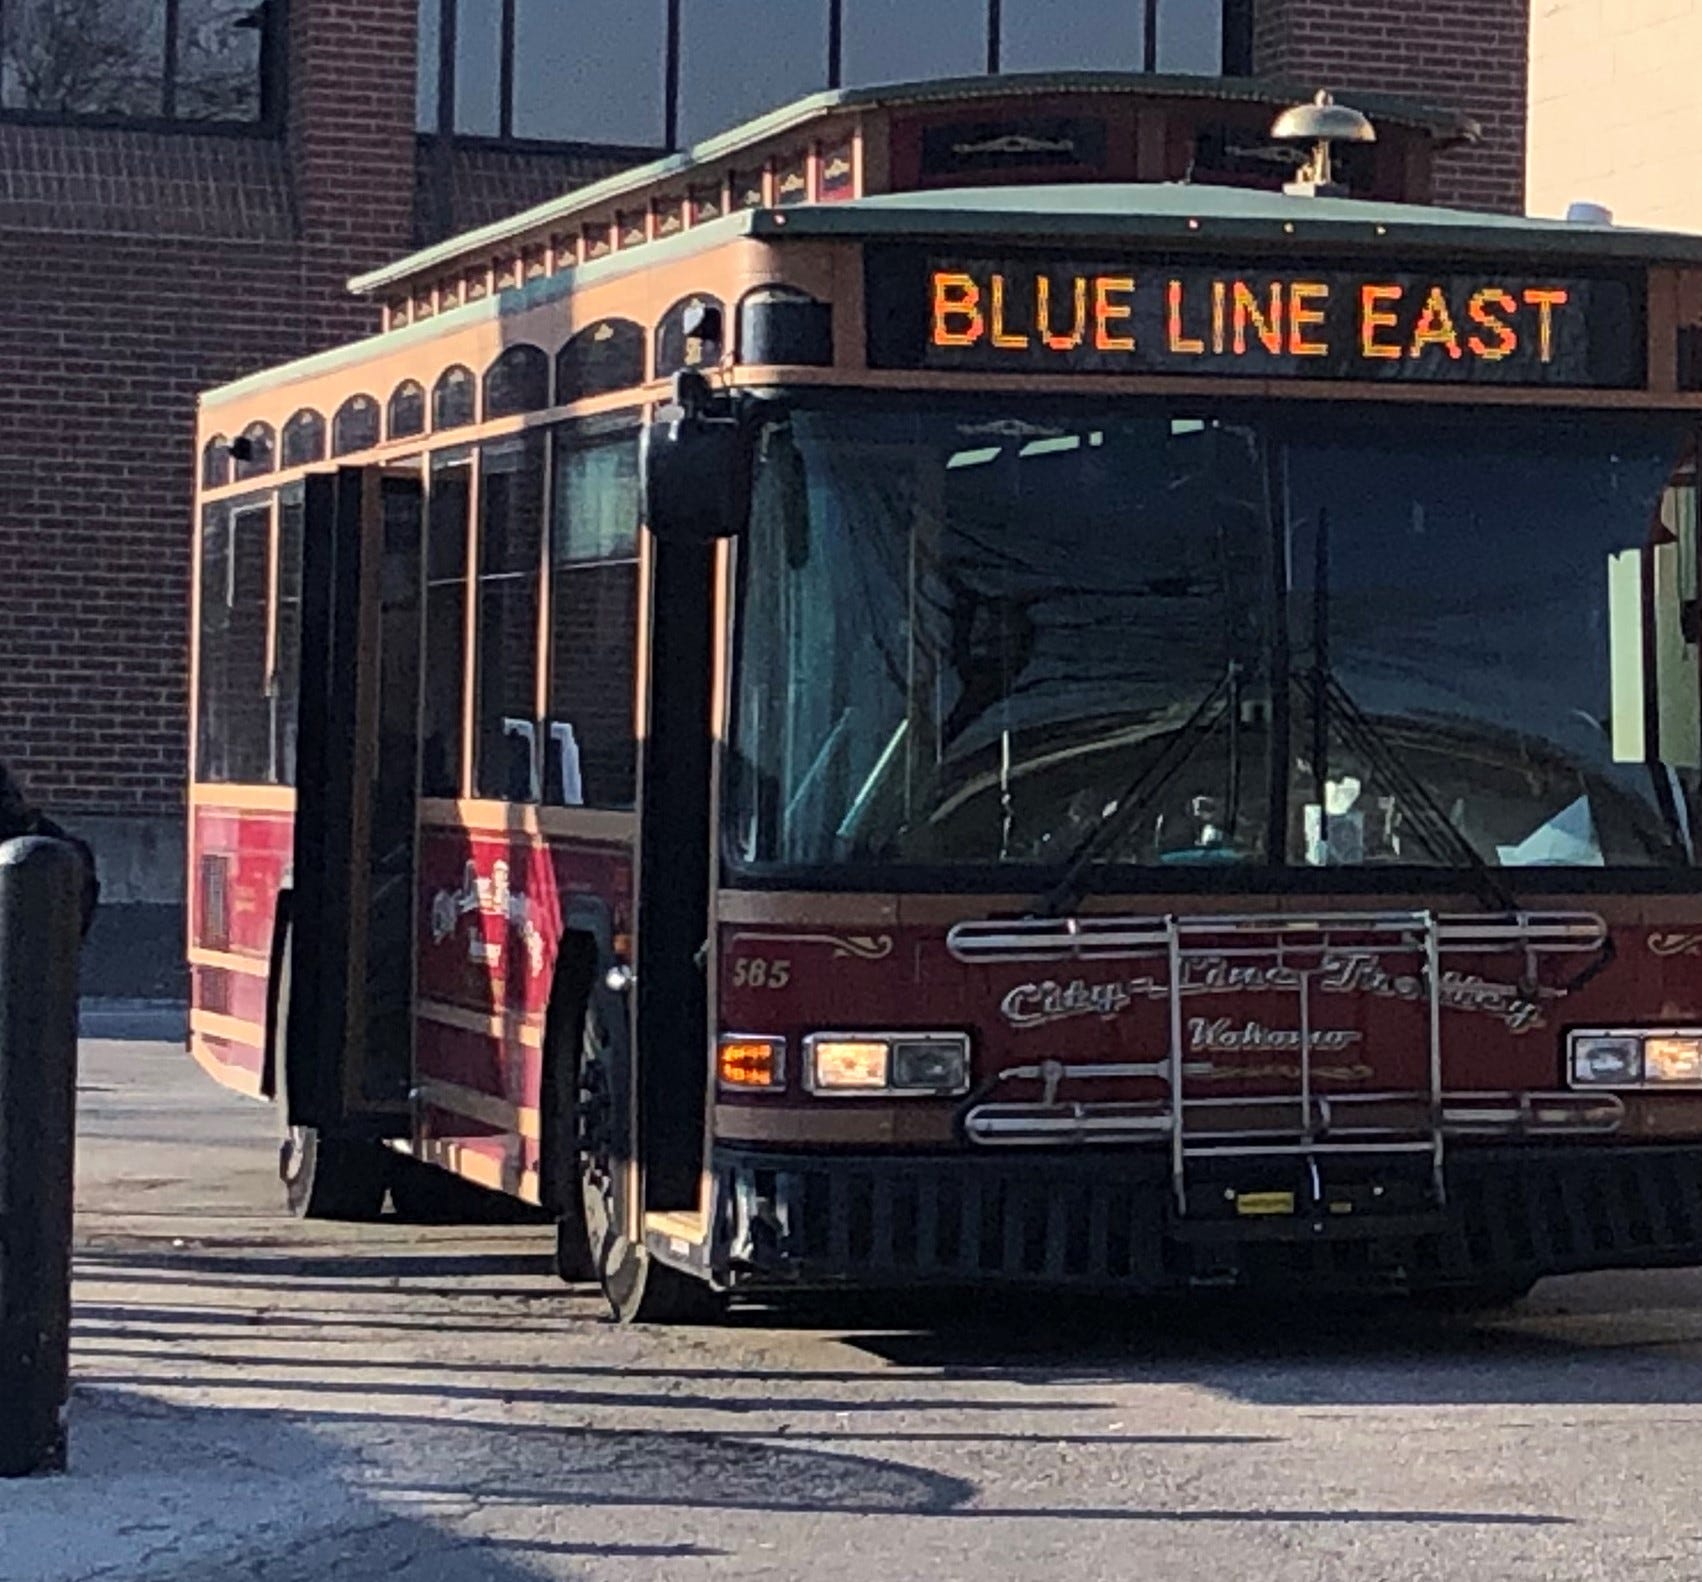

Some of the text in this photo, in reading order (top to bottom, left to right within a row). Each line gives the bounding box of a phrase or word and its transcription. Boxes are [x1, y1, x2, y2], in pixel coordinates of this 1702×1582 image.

[932, 271, 1567, 363] BLUE LINE EAST
[733, 957, 791, 988] 585
[1187, 1017, 1363, 1051] Kokomo
